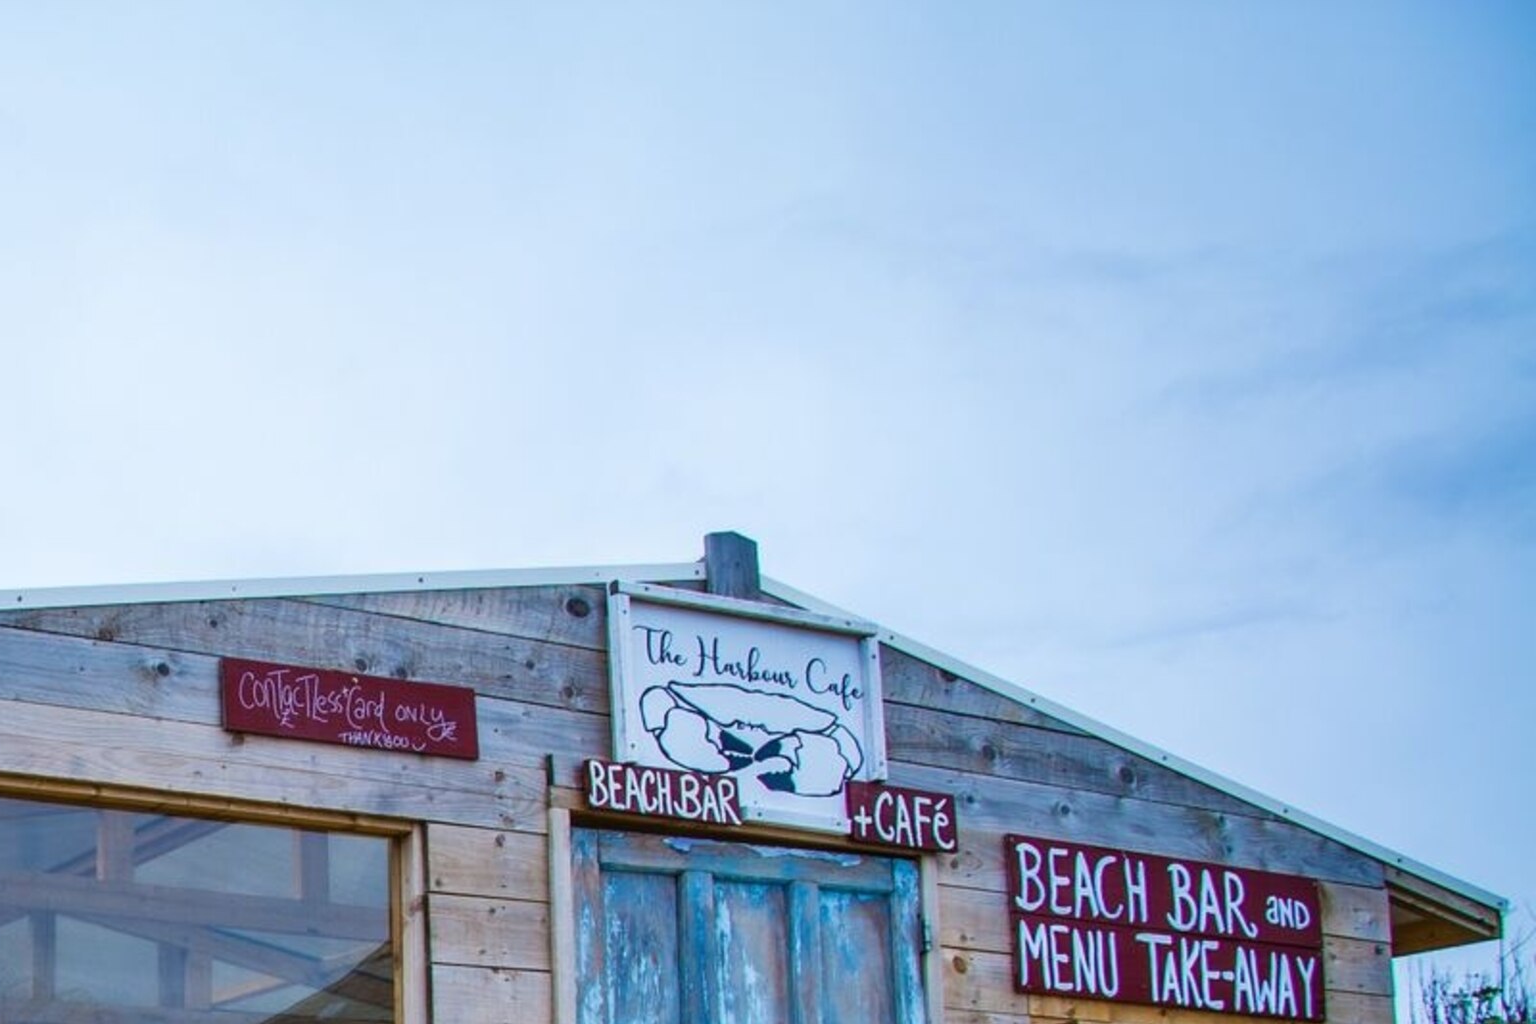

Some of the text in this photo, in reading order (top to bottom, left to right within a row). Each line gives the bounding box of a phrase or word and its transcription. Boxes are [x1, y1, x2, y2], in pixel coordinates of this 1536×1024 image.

[632, 626, 864, 711] The Harbour Cafe
[589, 760, 742, 825] BEACH BAR
[1015, 842, 1148, 924] BEACH
[1166, 863, 1258, 938] BAR
[1019, 919, 1315, 1019] MENU TAKE-AWAY
